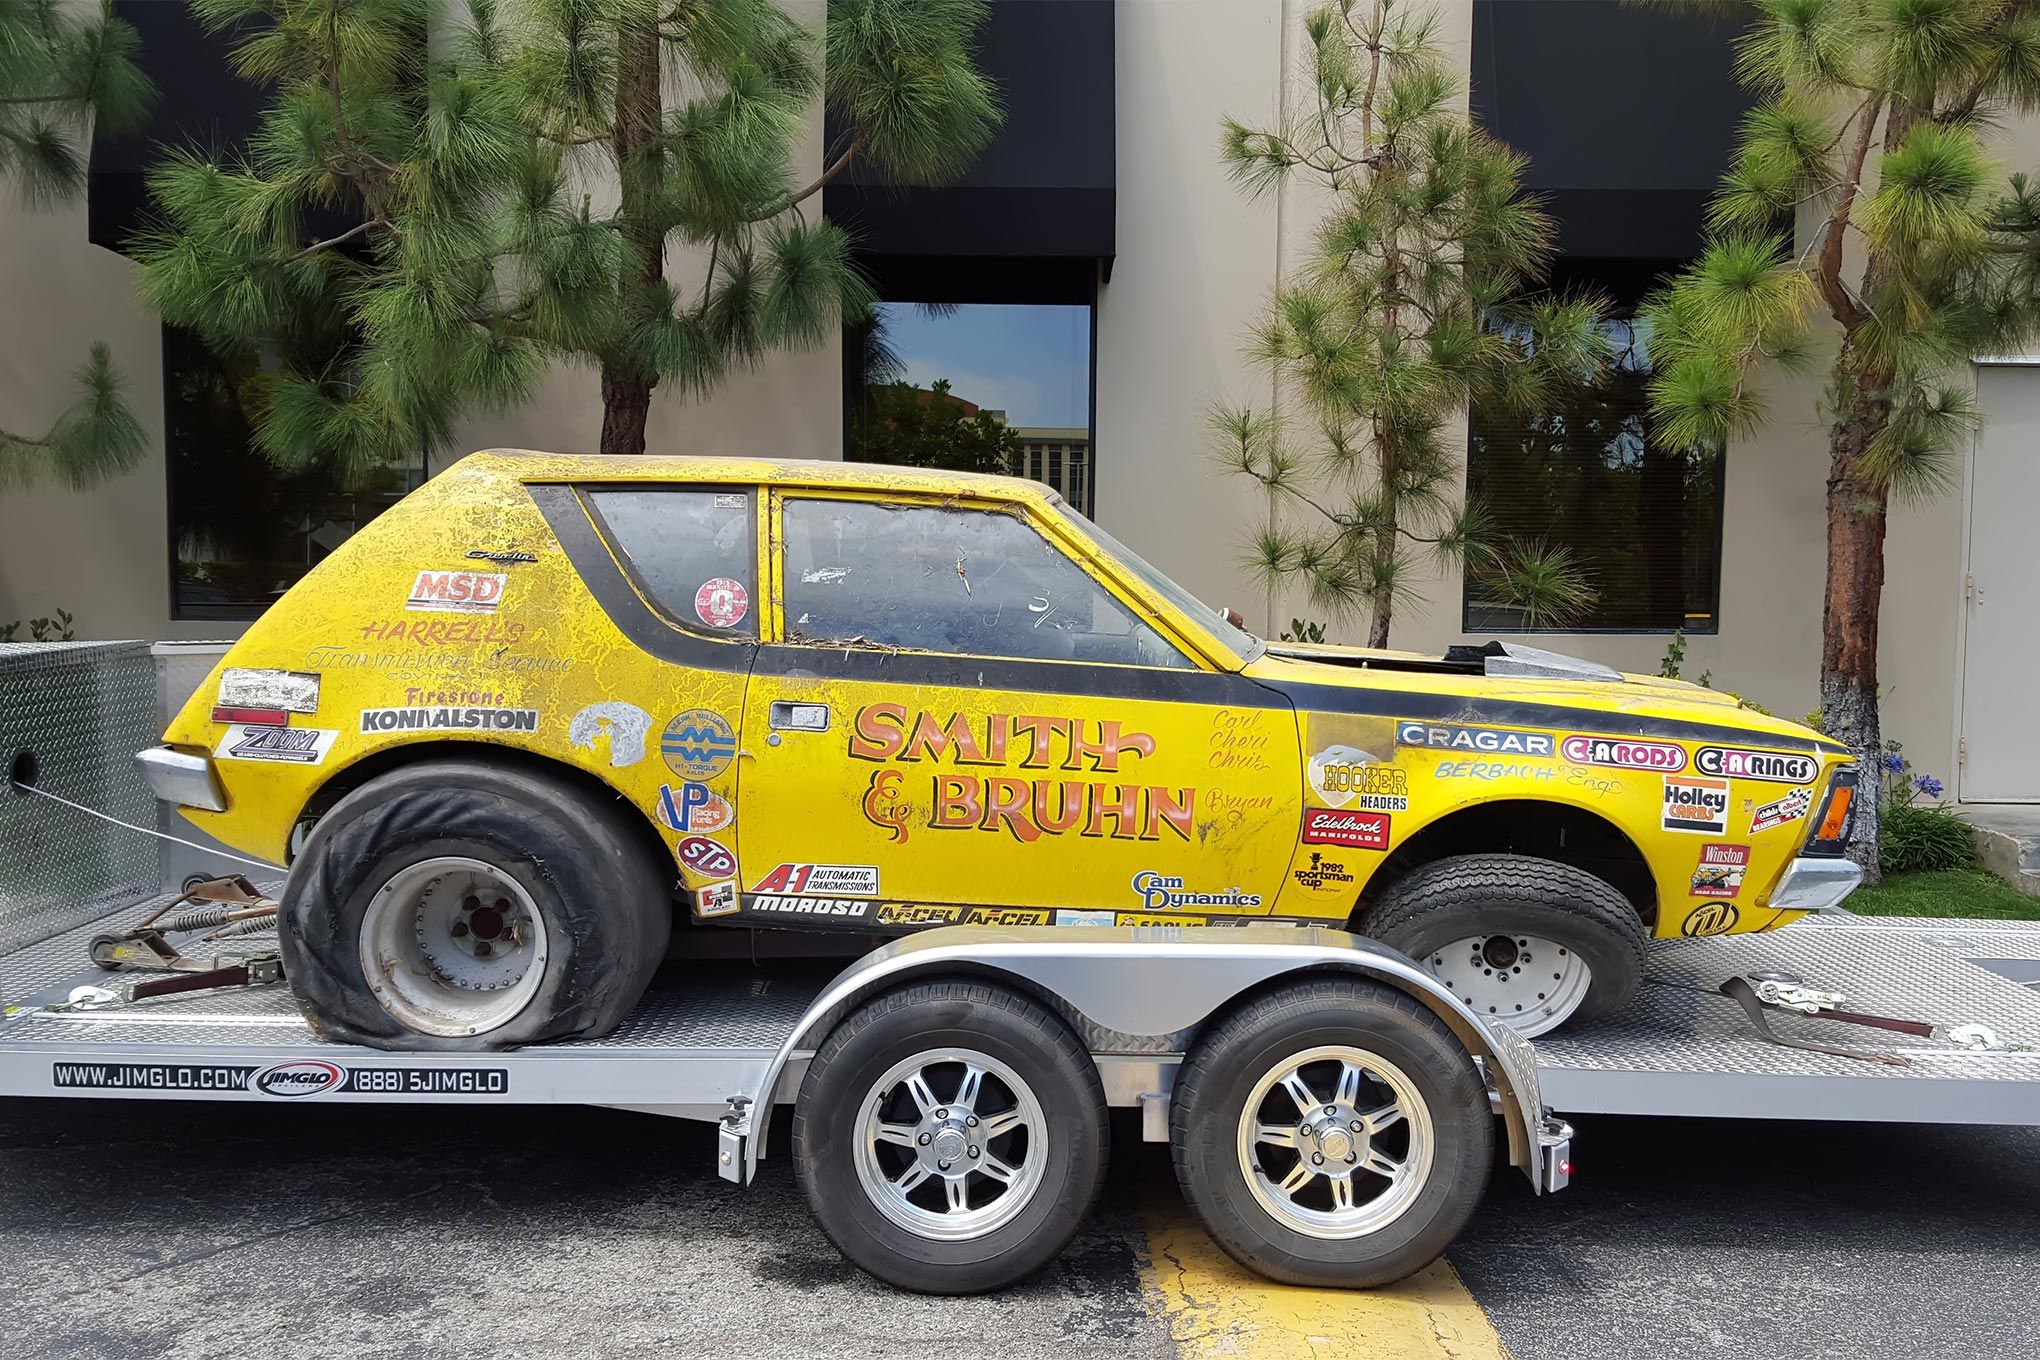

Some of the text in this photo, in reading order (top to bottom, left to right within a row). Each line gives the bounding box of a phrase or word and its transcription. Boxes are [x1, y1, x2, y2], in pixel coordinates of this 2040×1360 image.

[414, 573, 500, 602] MSD
[361, 620, 526, 646] HARRELL'S
[305, 645, 470, 671] Transmission
[405, 687, 505, 707] Firestone
[1213, 709, 1263, 730] Carl
[229, 727, 320, 756] ZOOM
[848, 702, 1156, 772] SMITH
[1402, 724, 1549, 755] CRAGAR
[675, 762, 718, 772] HI-TORQUE
[1323, 765, 1408, 796] HOOKER
[659, 782, 709, 832] VP
[862, 769, 1197, 844] & BRUHN
[1360, 796, 1407, 811] HEADERS
[1665, 785, 1725, 813] Holley
[692, 808, 720, 819] Racing
[1668, 804, 1716, 821] CARBS
[1311, 814, 1382, 834] Edelbrock
[1752, 817, 1781, 832] BEARINGS
[1309, 831, 1381, 843] MANIFOLDS
[684, 842, 731, 871] STP
[1705, 846, 1744, 864] Winston
[812, 870, 872, 881] AUTOMATIC
[1294, 869, 1354, 883] sportsman
[1320, 862, 1345, 873] 1982
[807, 880, 876, 892] TRANSMISSIONS
[1132, 872, 1184, 892] Cam
[1300, 878, 1323, 891] cup
[752, 896, 869, 916] MOROSO
[1144, 888, 1262, 909] Dynamics
[56, 1066, 246, 1088] WWW.JIMGLO.COM
[264, 1072, 331, 1086] JIMGLO
[353, 1071, 501, 1091] (888) 5JIMGLO
